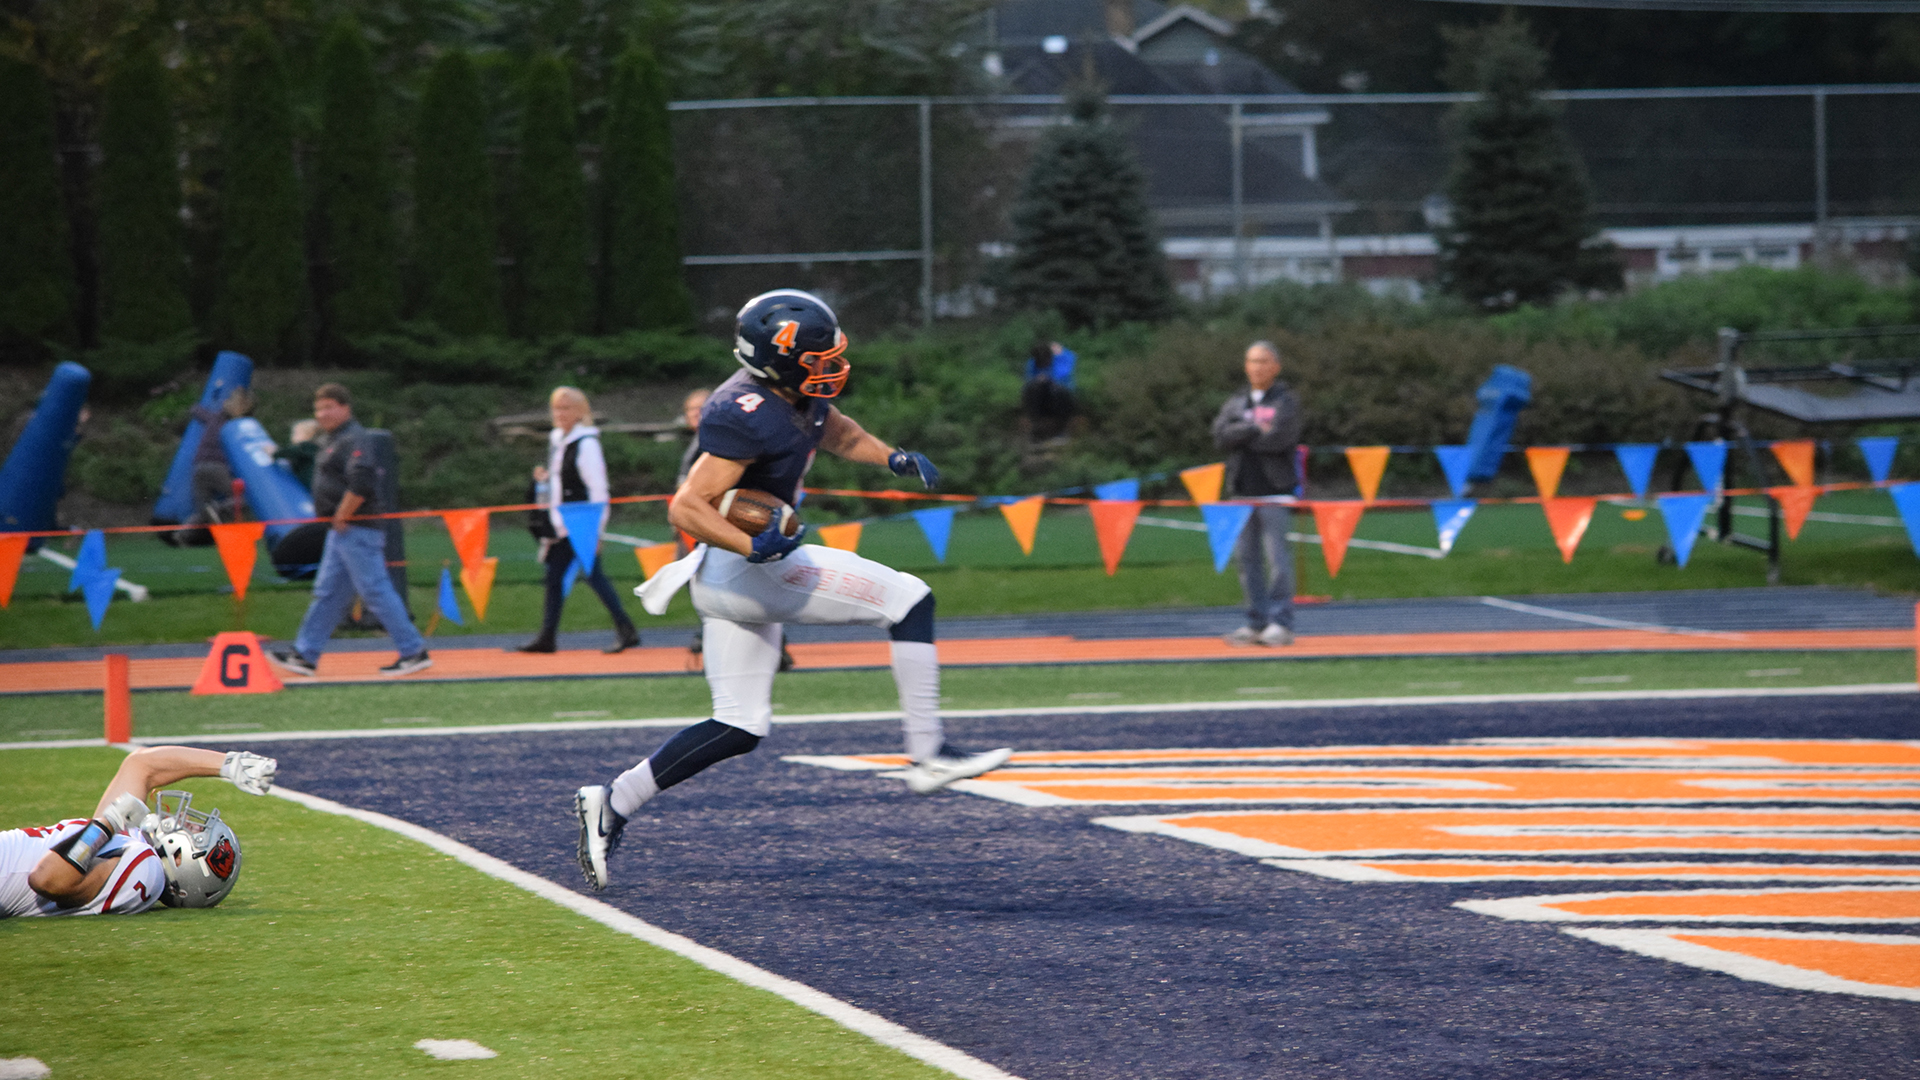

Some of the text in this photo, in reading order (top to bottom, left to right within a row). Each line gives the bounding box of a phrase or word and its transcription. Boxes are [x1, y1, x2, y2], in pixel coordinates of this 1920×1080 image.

[771, 320, 800, 356] 4
[735, 392, 765, 413] 4
[220, 644, 250, 688] G
